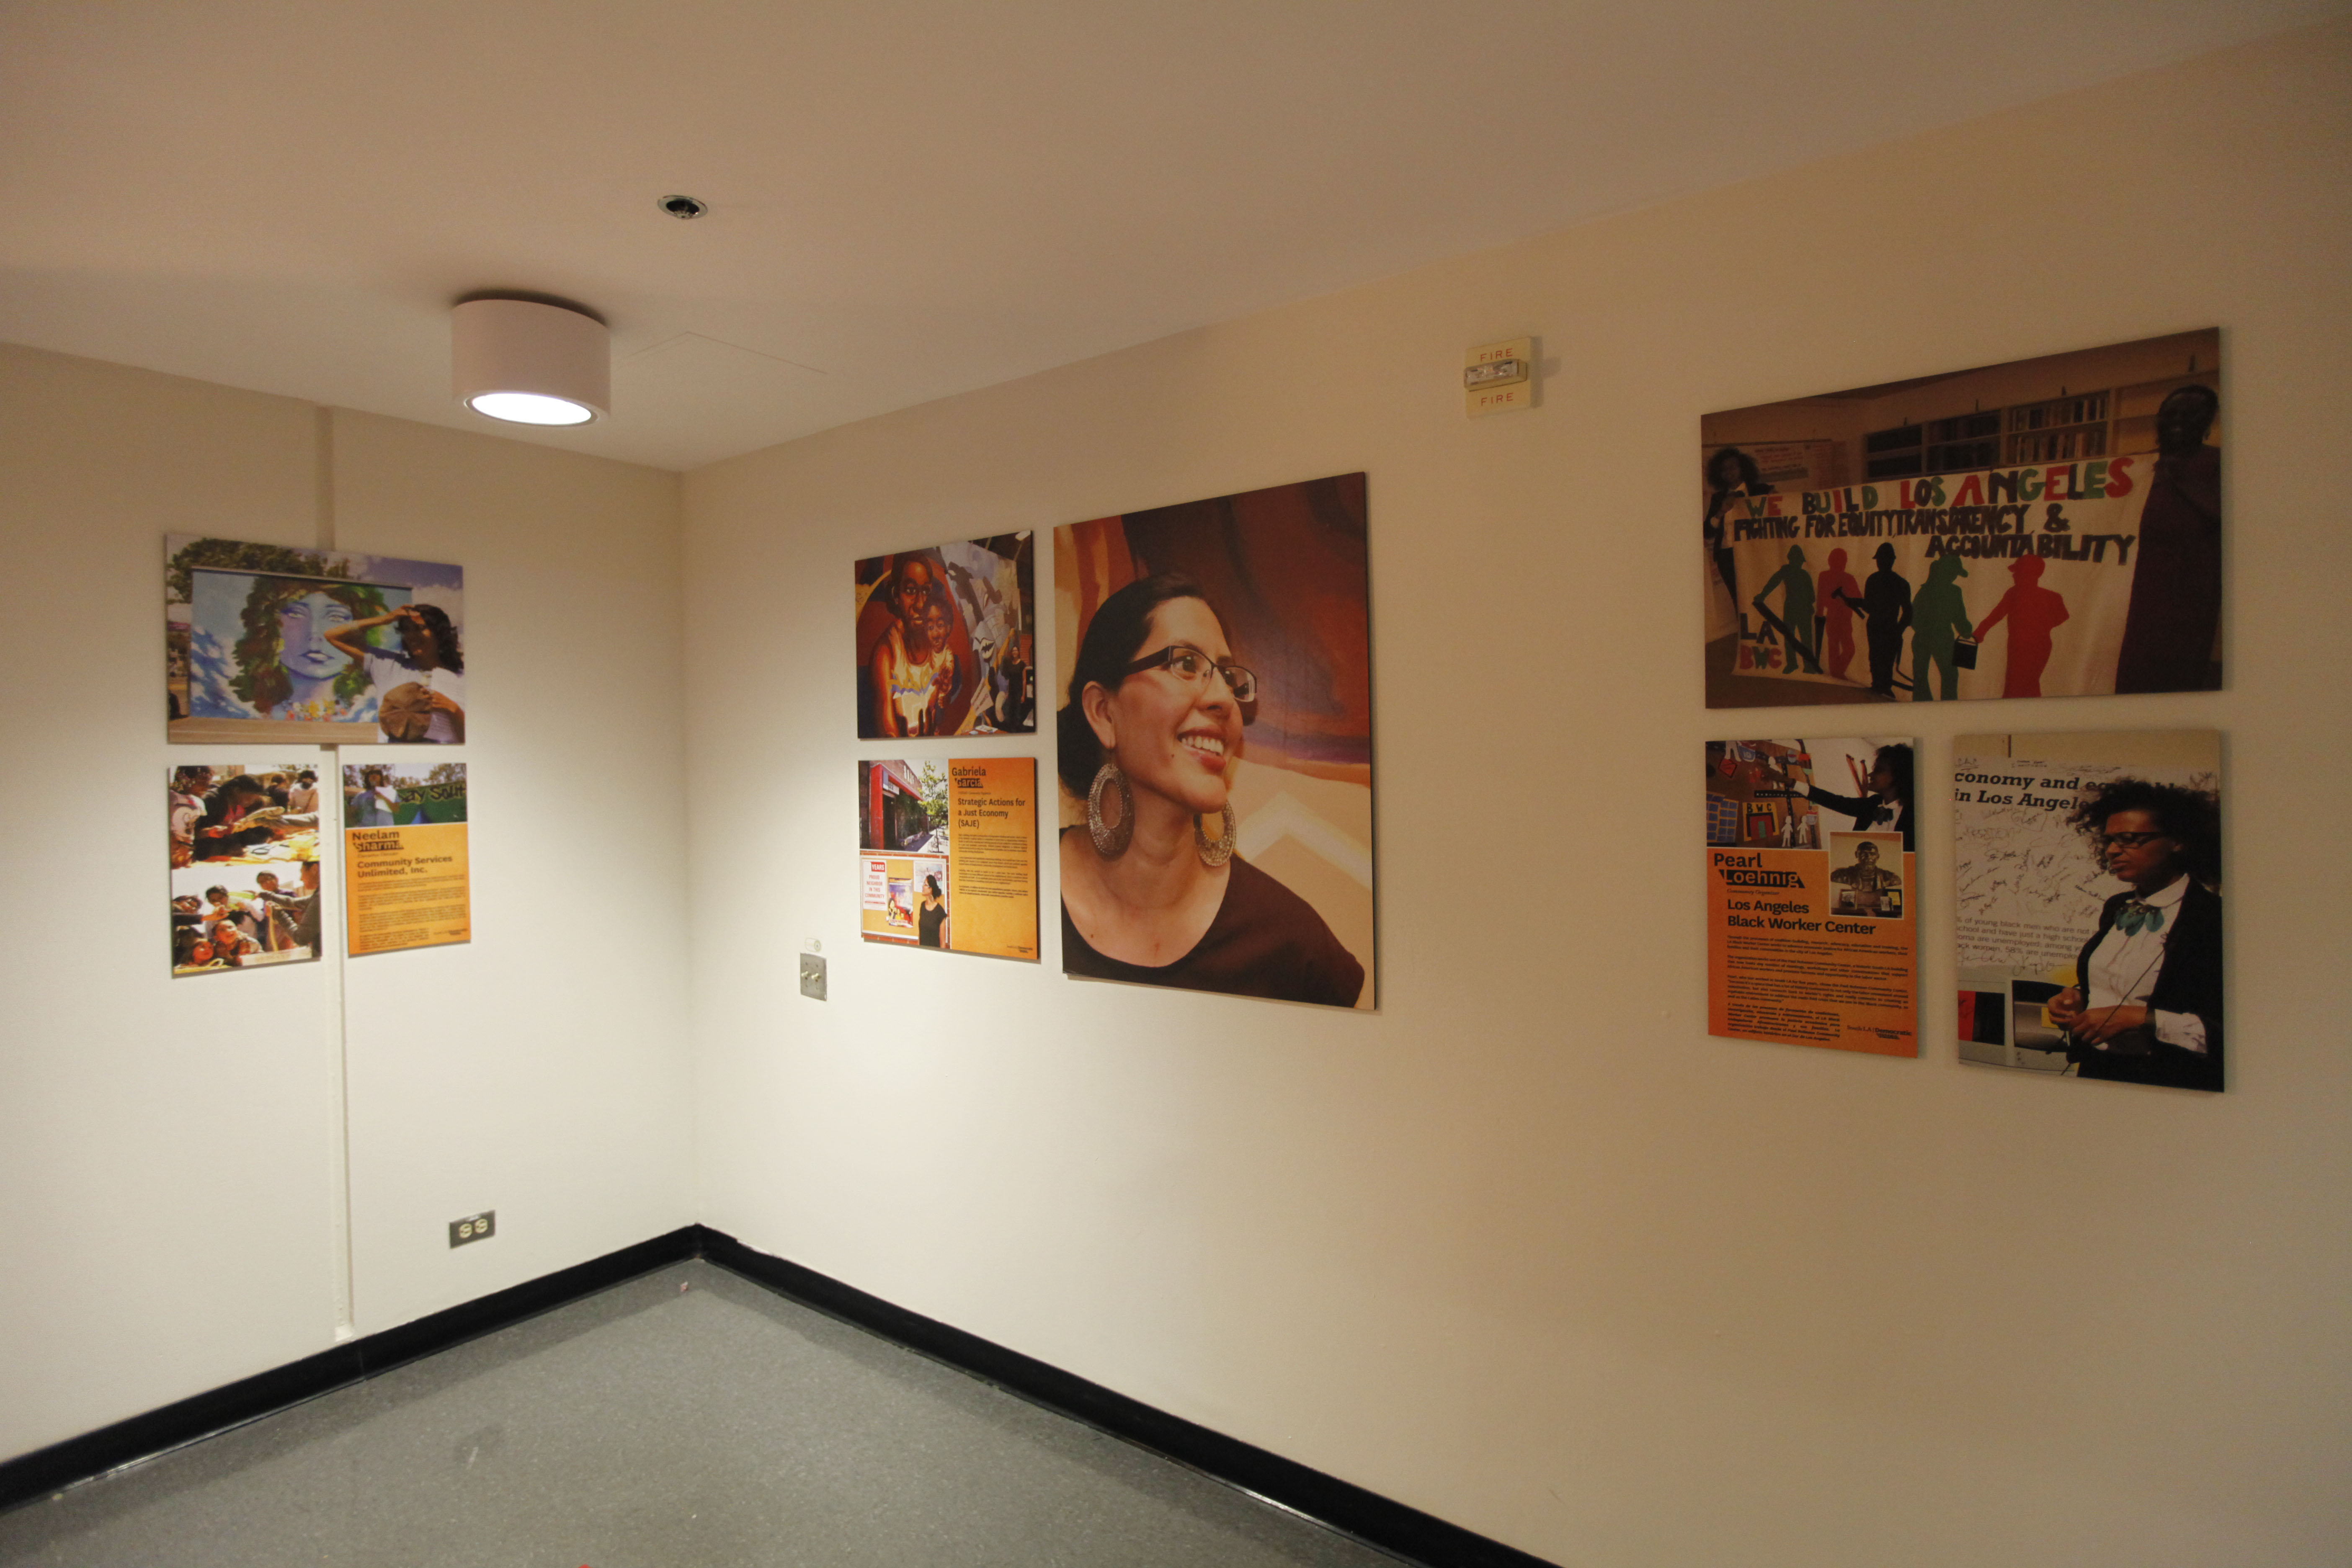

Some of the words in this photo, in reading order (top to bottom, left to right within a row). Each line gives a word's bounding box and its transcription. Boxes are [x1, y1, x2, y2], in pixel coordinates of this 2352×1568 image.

[1480, 348, 1513, 362] FIRE
[1481, 392, 1514, 406] FIRE
[1745, 496, 1782, 518] WE
[1802, 486, 1878, 515] BUILD
[1900, 476, 1946, 508] LOS
[1951, 457, 2134, 507] ANGELES
[1734, 516, 1800, 542] FIGHTING
[1805, 513, 1836, 538] FOR
[2044, 503, 2071, 533] &
[1925, 534, 2136, 565] ACCOUNTABILITY
[1739, 613, 1778, 645] LA
[1739, 645, 1782, 670] BWC
[952, 766, 986, 776] Gabriela
[1955, 772, 2035, 790] conomy
[2040, 777, 2080, 789] and
[958, 798, 987, 807] Strategic
[1955, 788, 1970, 802] in
[1977, 790, 2013, 805] Los
[2017, 793, 2089, 811] Angele
[979, 809, 1008, 819] Economy
[1747, 803, 1772, 813] BWC
[958, 819, 980, 829] (SAJE)
[352, 830, 400, 840] Neelam
[357, 858, 413, 868] Community
[415, 856, 453, 864] Services
[1714, 853, 1762, 868] Pearl
[1723, 869, 1801, 888] Loehnig
[1728, 899, 1751, 910] Los
[1754, 900, 1809, 915] Angeles
[1728, 916, 1765, 928] Black
[1768, 918, 1821, 931] Worker
[1825, 921, 1876, 934] Center
[1974, 919, 1998, 927] young
